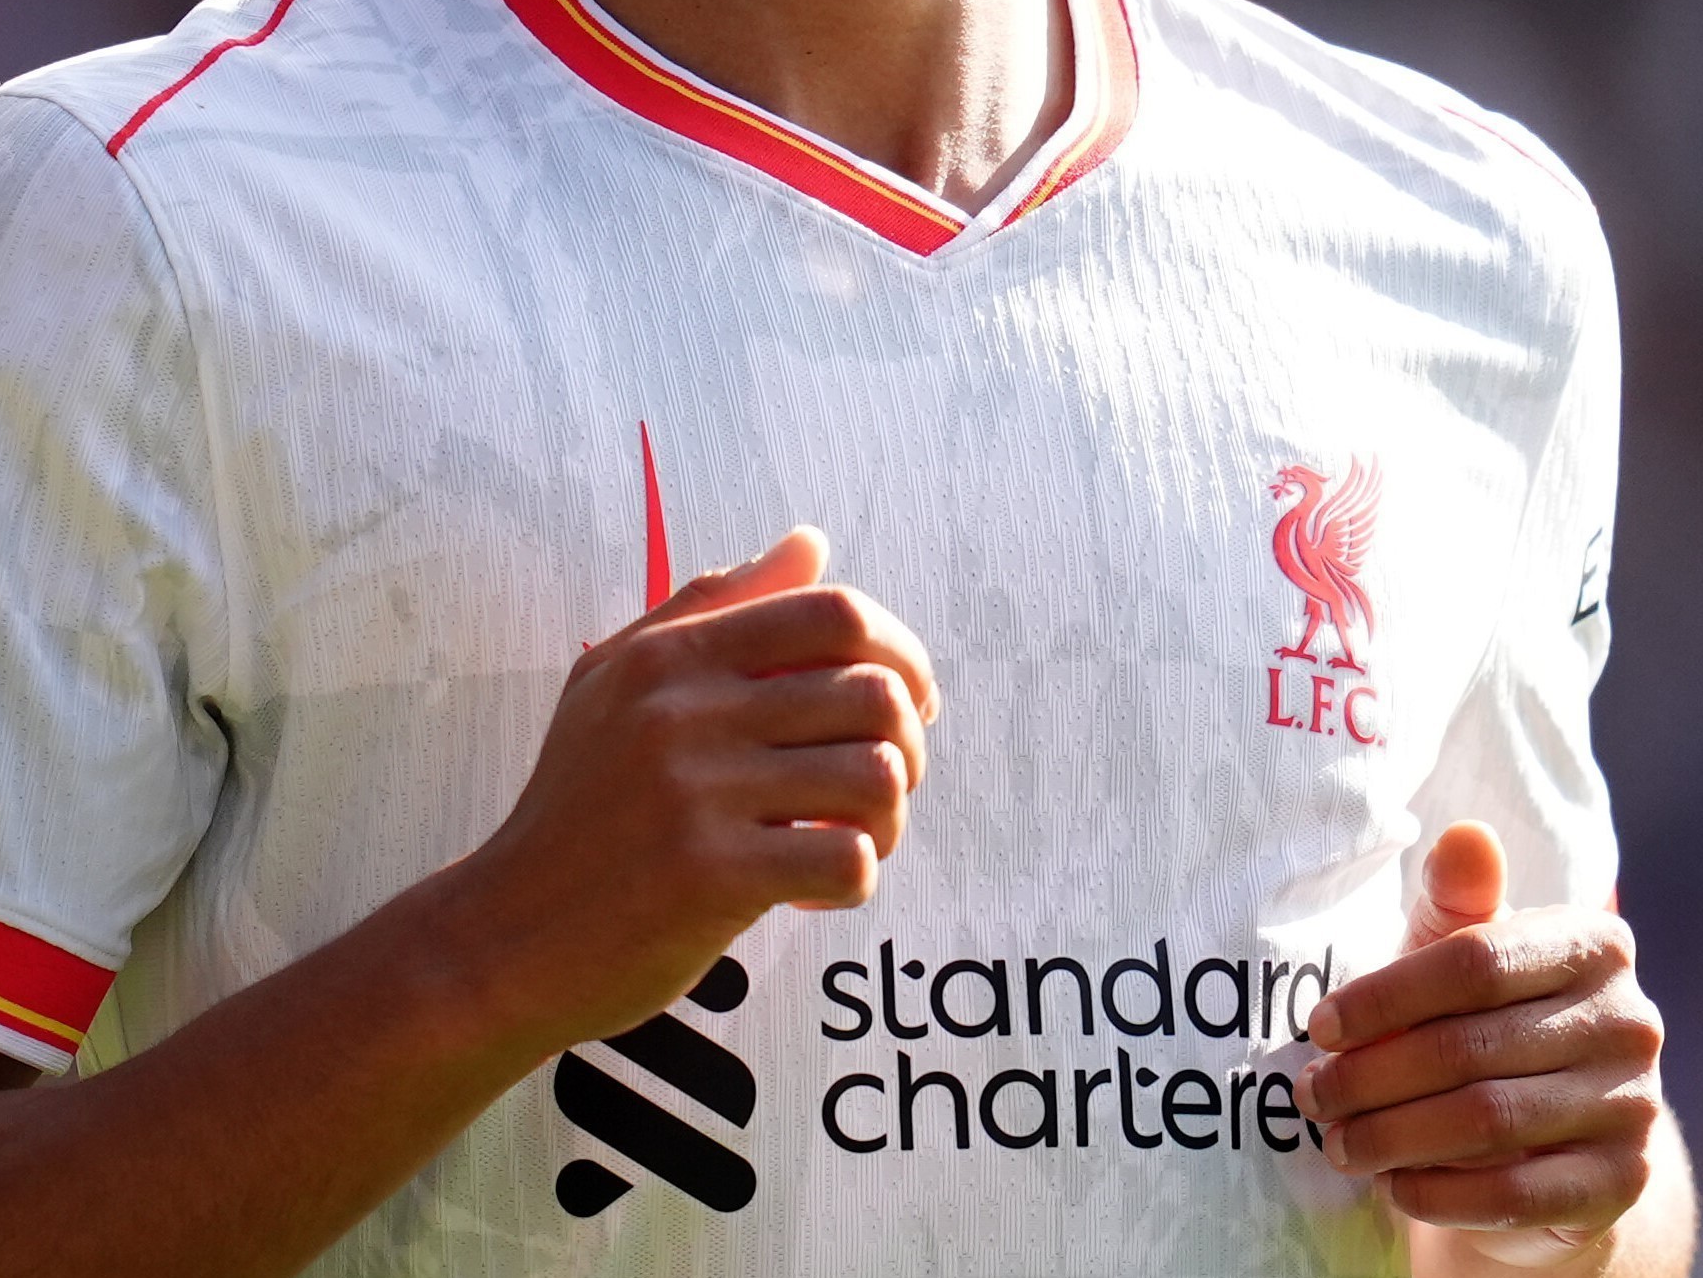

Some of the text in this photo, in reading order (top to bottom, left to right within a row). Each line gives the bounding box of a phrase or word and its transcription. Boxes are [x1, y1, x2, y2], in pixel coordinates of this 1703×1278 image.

[1266, 668, 1387, 747] L.F.C.
[820, 937, 1333, 1043] standard
[820, 1046, 1324, 1153] chartere
